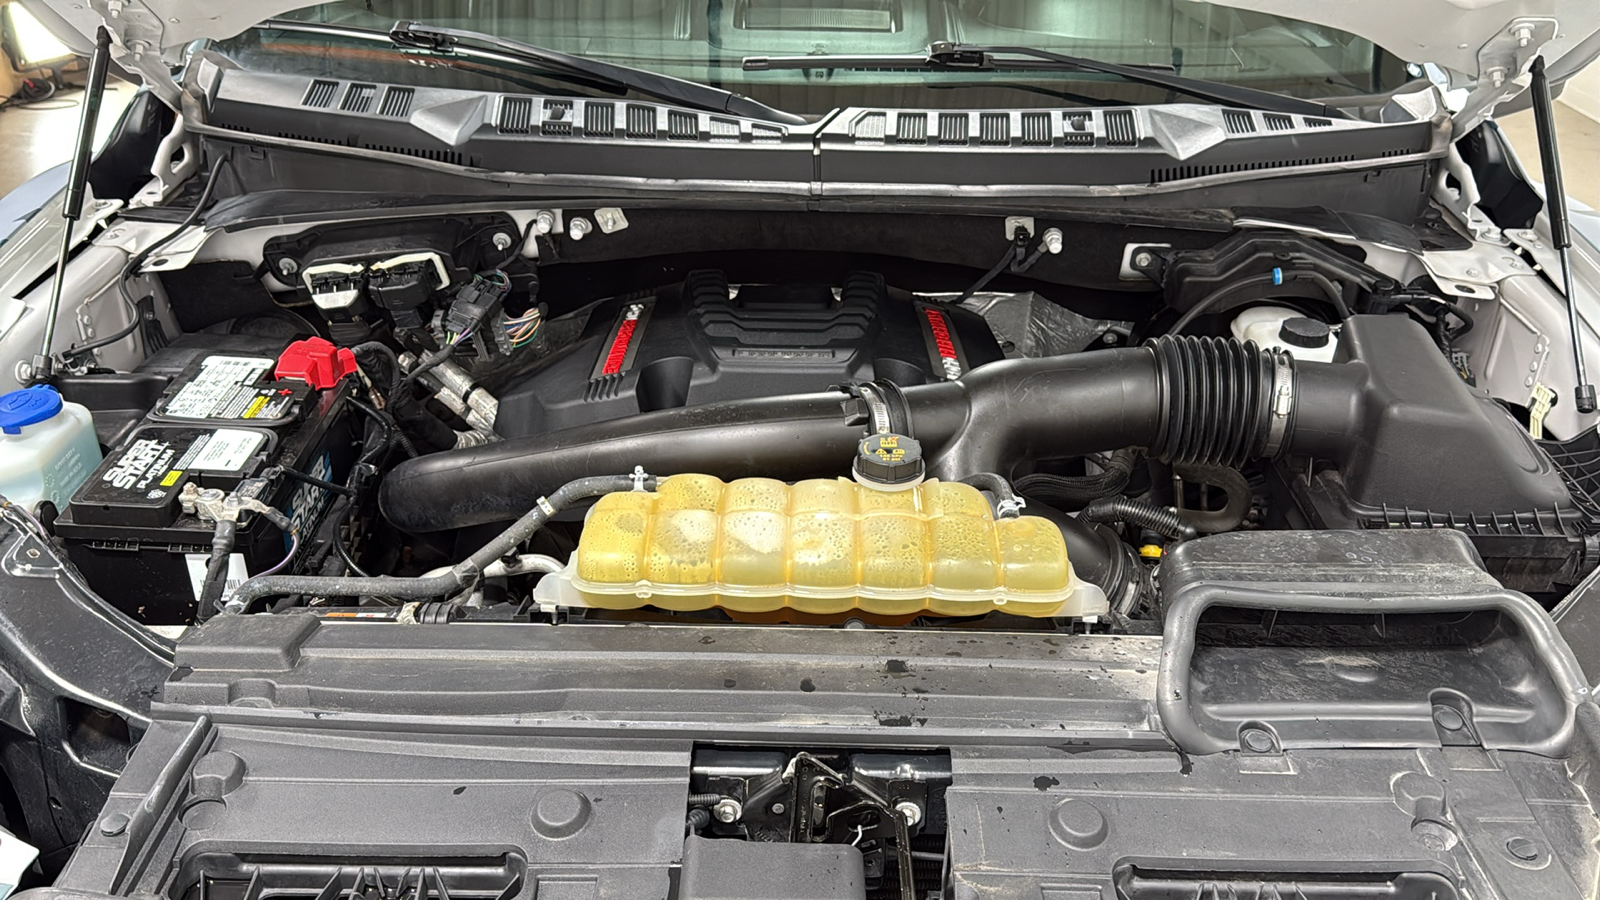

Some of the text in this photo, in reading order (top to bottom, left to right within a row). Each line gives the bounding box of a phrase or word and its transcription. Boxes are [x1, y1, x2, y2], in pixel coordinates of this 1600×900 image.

[102, 439, 153, 482] SUPER
[112, 439, 164, 490] START
[136, 448, 176, 489] PLATINUM
